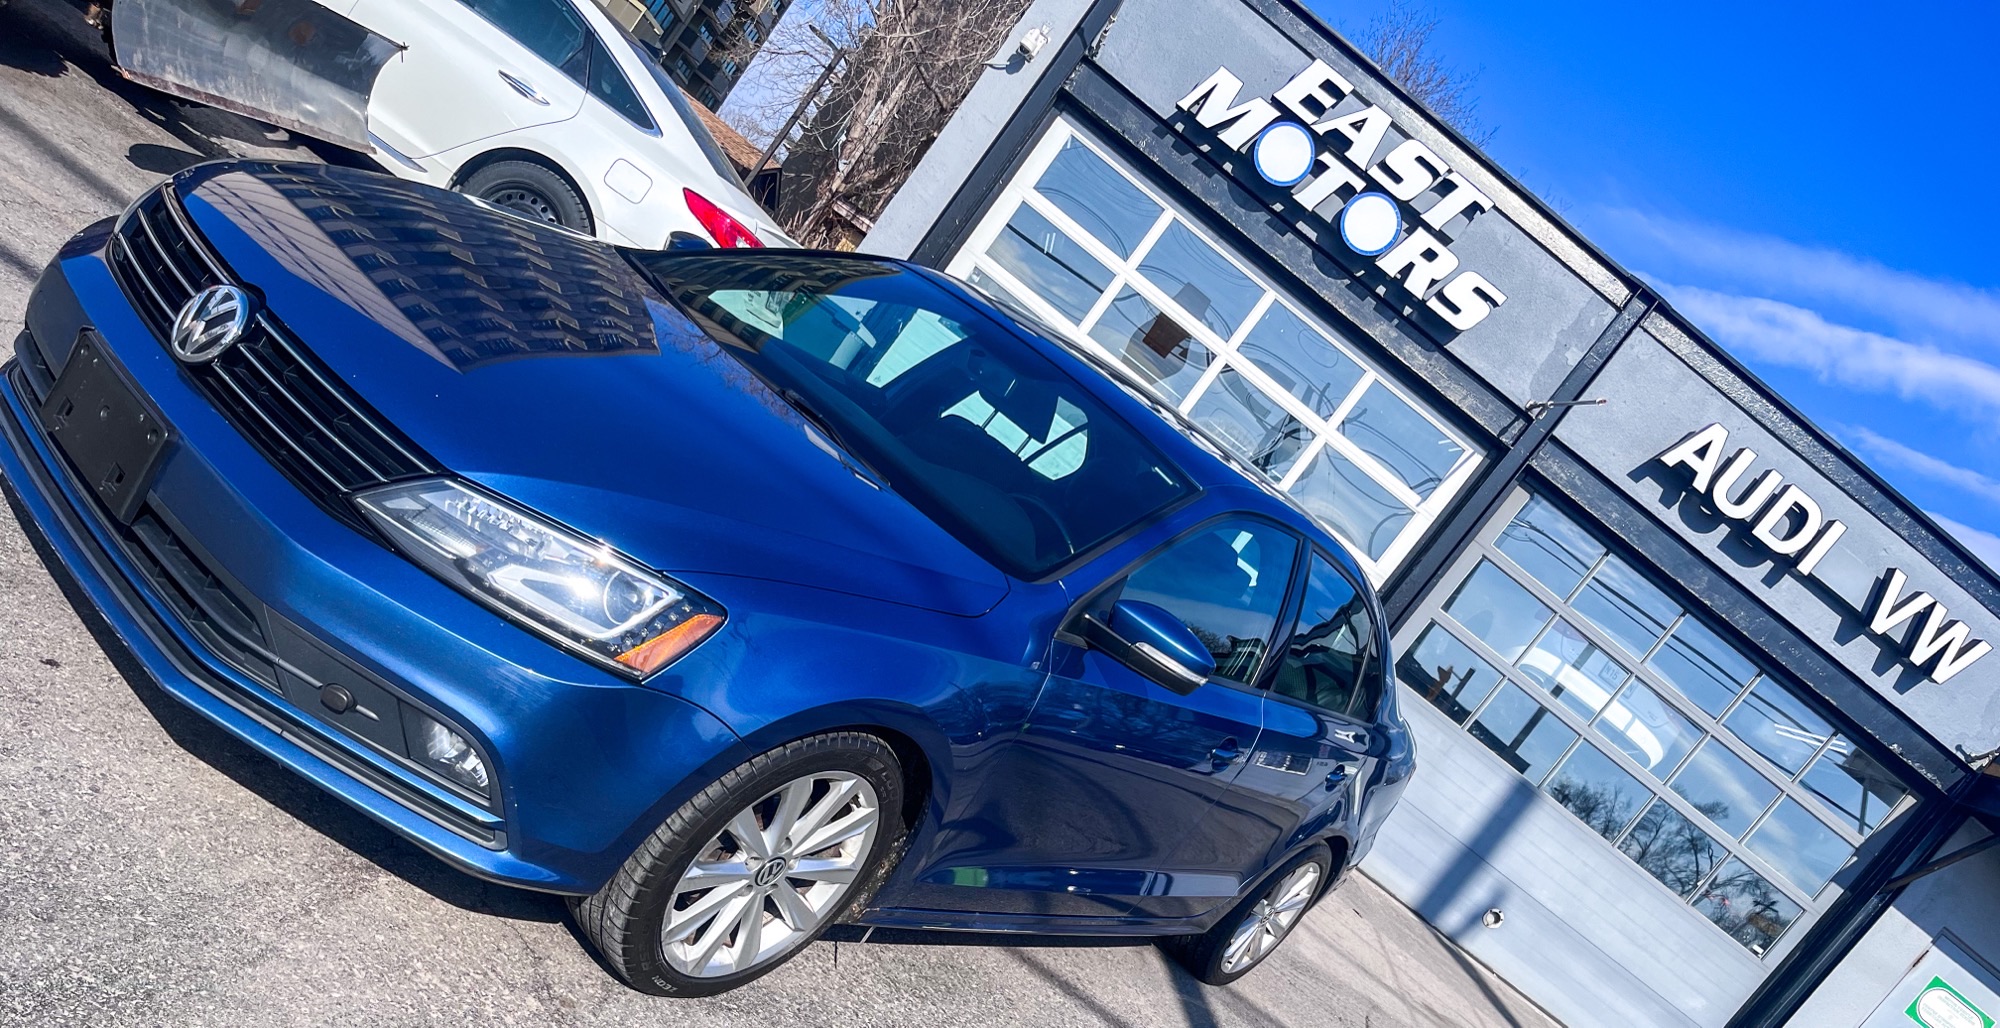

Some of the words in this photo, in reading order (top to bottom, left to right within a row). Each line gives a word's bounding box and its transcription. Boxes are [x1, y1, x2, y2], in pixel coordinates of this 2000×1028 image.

[1176, 65, 1508, 331] MOTORS
[1271, 58, 1495, 231] EAST
[1660, 422, 1848, 577] AUDI
[1869, 567, 1994, 685] VW
